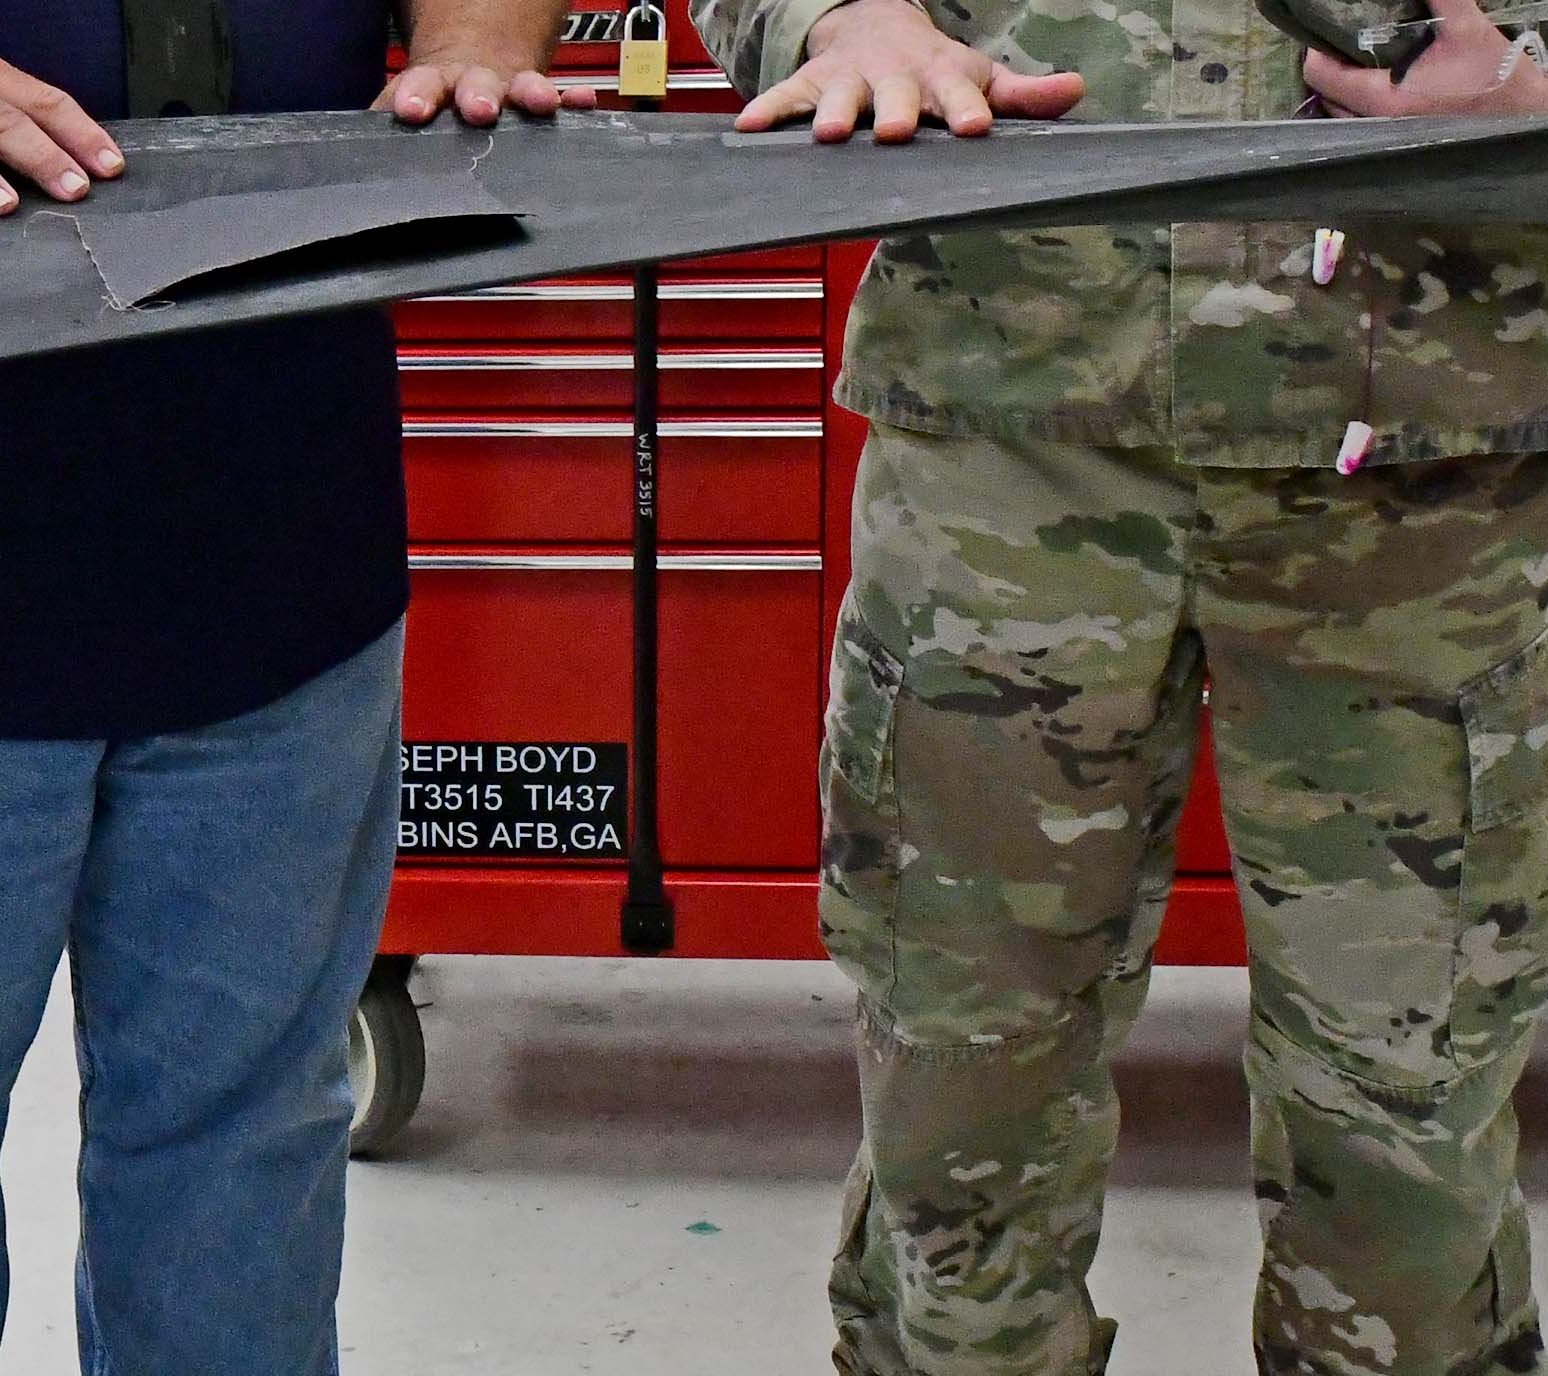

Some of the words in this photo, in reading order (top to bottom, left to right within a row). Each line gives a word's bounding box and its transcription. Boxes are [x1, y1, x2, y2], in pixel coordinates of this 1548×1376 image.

[637, 433, 652, 476] WRT
[639, 481, 653, 518] 3515
[496, 746, 597, 773] BOYD
[401, 783, 503, 811] T3515
[523, 784, 615, 811] TI437
[397, 820, 479, 848] BINS
[488, 823, 622, 853] AFB,GA
